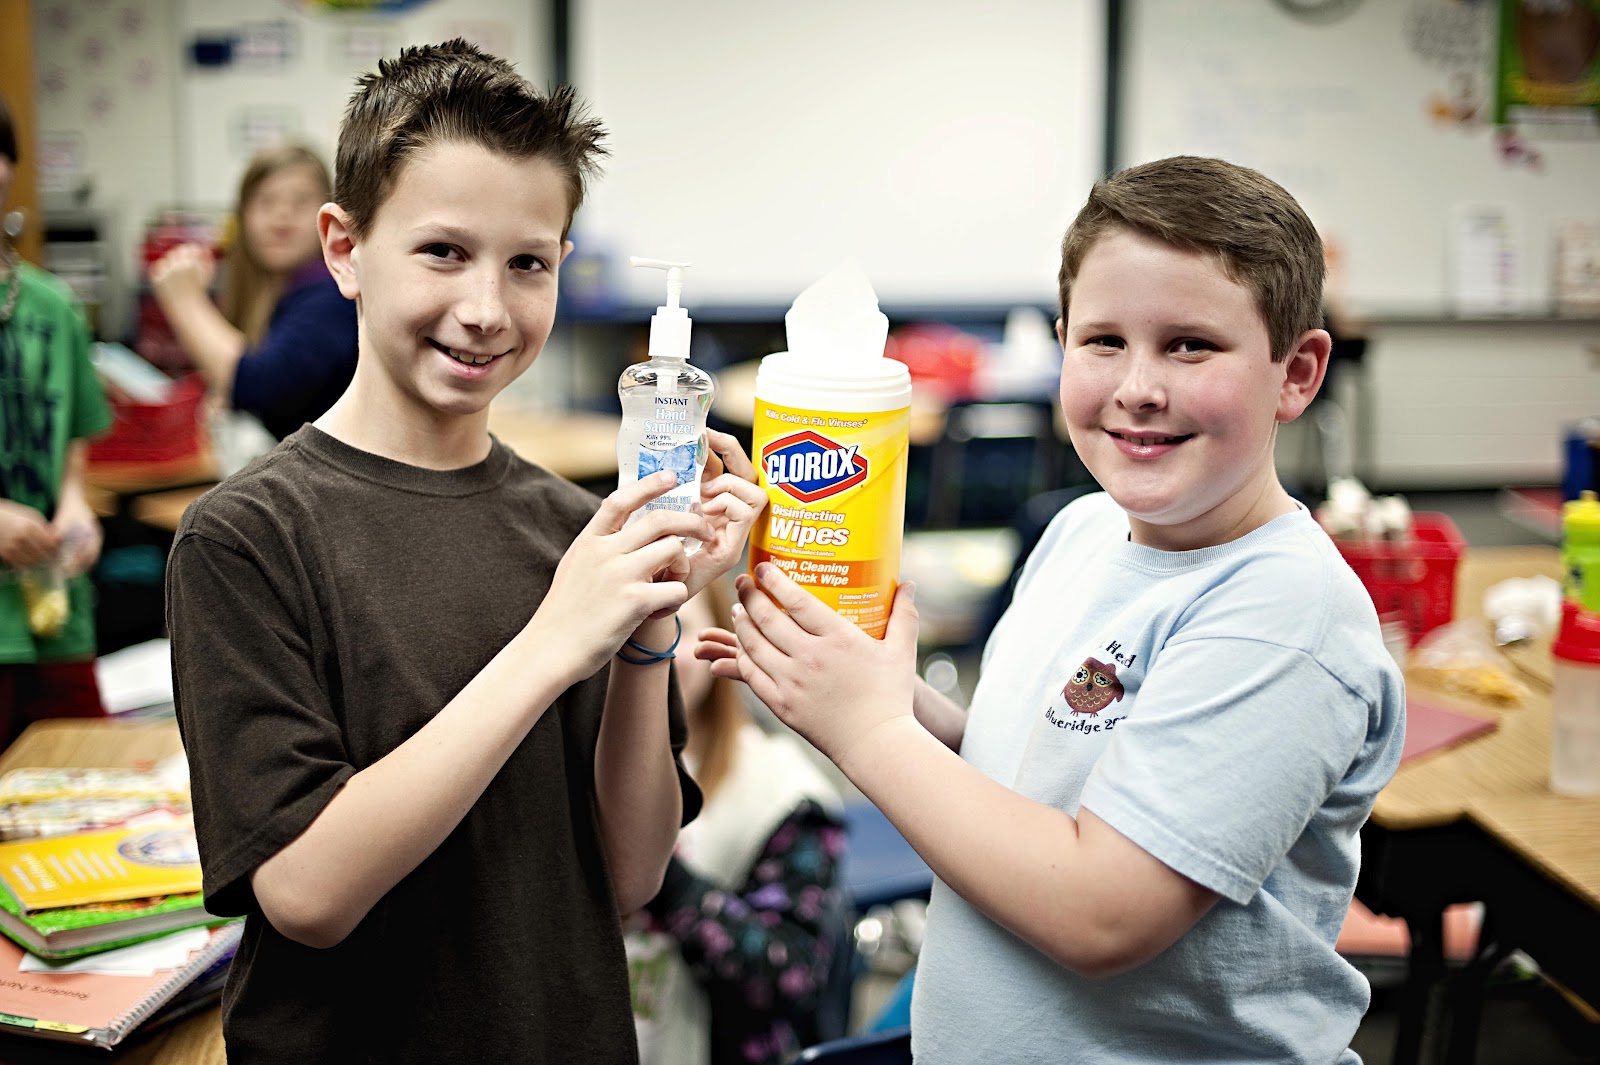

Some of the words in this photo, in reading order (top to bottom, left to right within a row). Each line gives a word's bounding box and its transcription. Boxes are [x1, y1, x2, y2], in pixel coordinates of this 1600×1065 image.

[654, 397, 688, 406] INSTANT
[655, 408, 687, 421] Hand
[765, 409, 779, 420] Kills
[780, 413, 800, 424] Cold
[801, 416, 809, 425] &
[810, 416, 826, 426] Flu
[644, 420, 695, 435] Sanitizer
[767, 445, 859, 484] CLOROX
[772, 503, 845, 524] Disinfecting
[770, 516, 850, 548] Wipes
[799, 560, 849, 575] Cleaning
[788, 571, 817, 584] Thick
[820, 574, 849, 587] Wipe
[862, 591, 879, 599] Fresh
